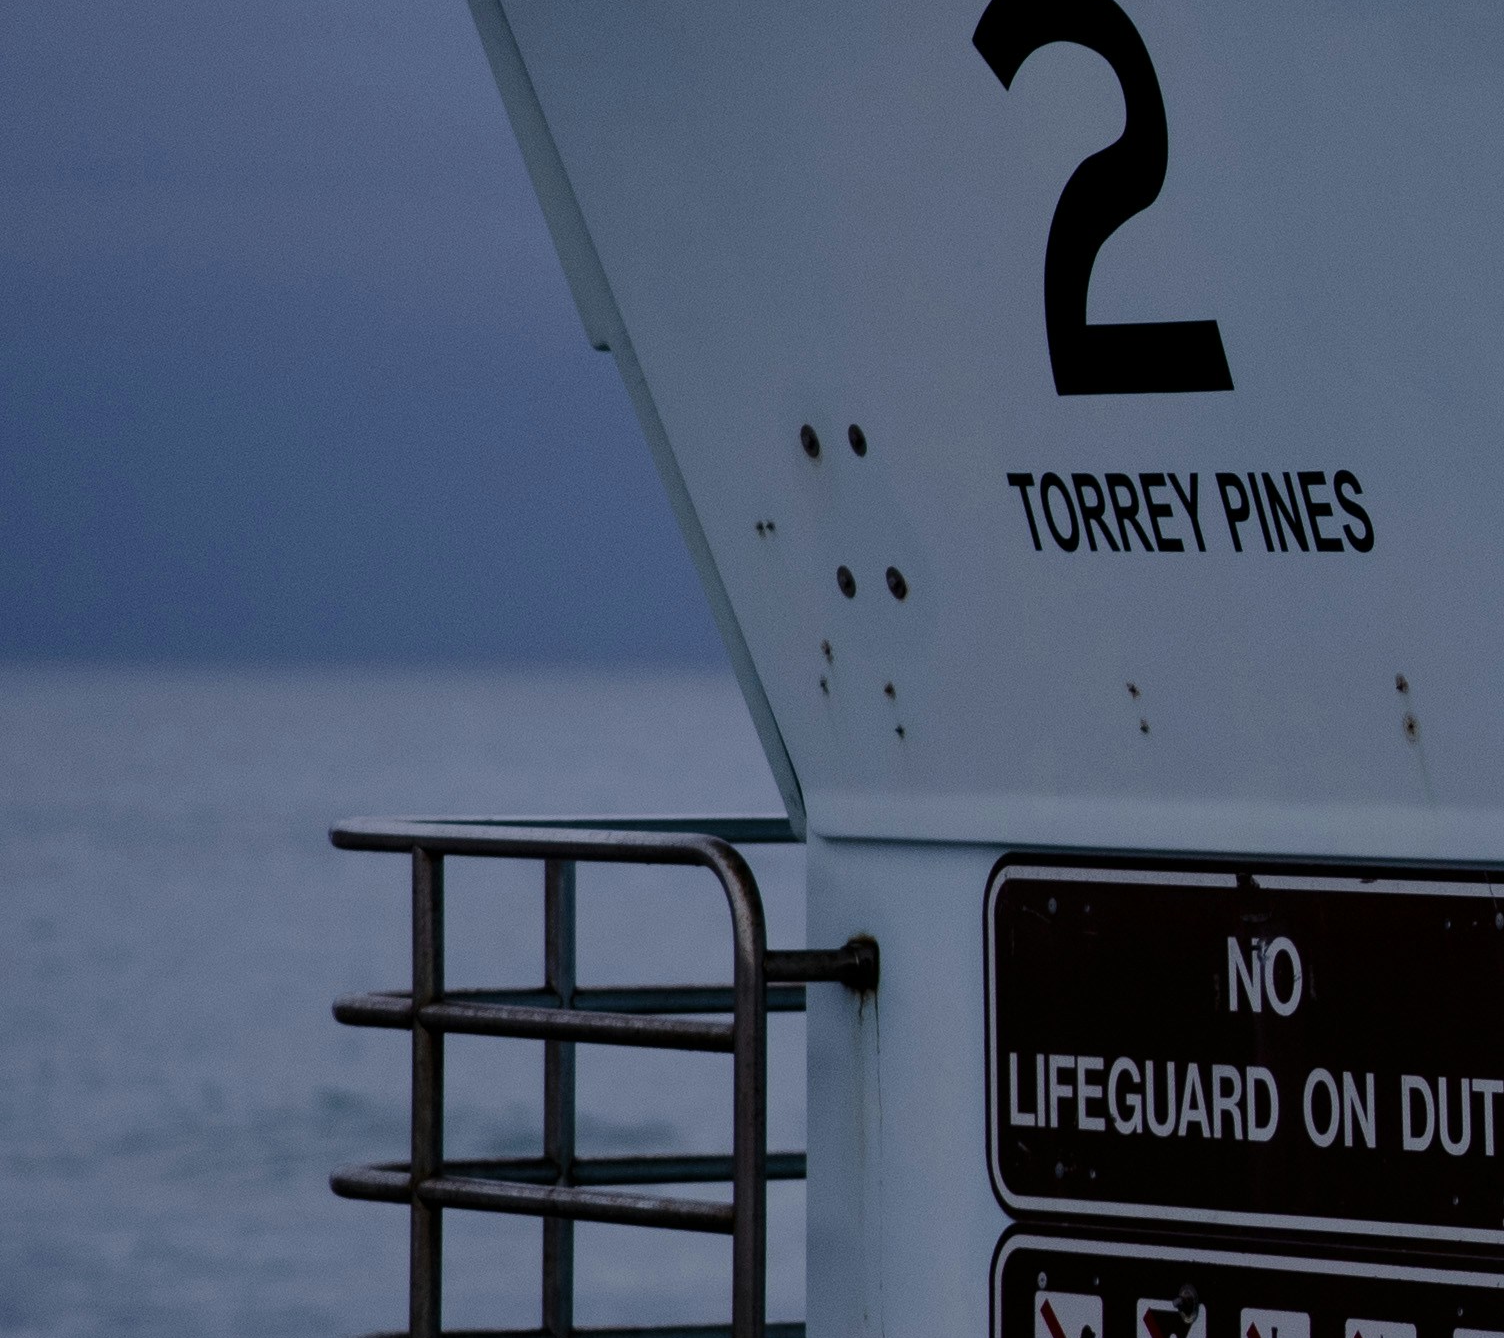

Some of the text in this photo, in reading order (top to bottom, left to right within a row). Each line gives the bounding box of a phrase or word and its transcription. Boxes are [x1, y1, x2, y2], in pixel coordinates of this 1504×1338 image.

[1007, 470, 1374, 553] TORREY PINES
[1224, 934, 1305, 1019] NO
[1010, 1053, 1279, 1141] LIFEGUARD
[1304, 1068, 1376, 1148] ON
